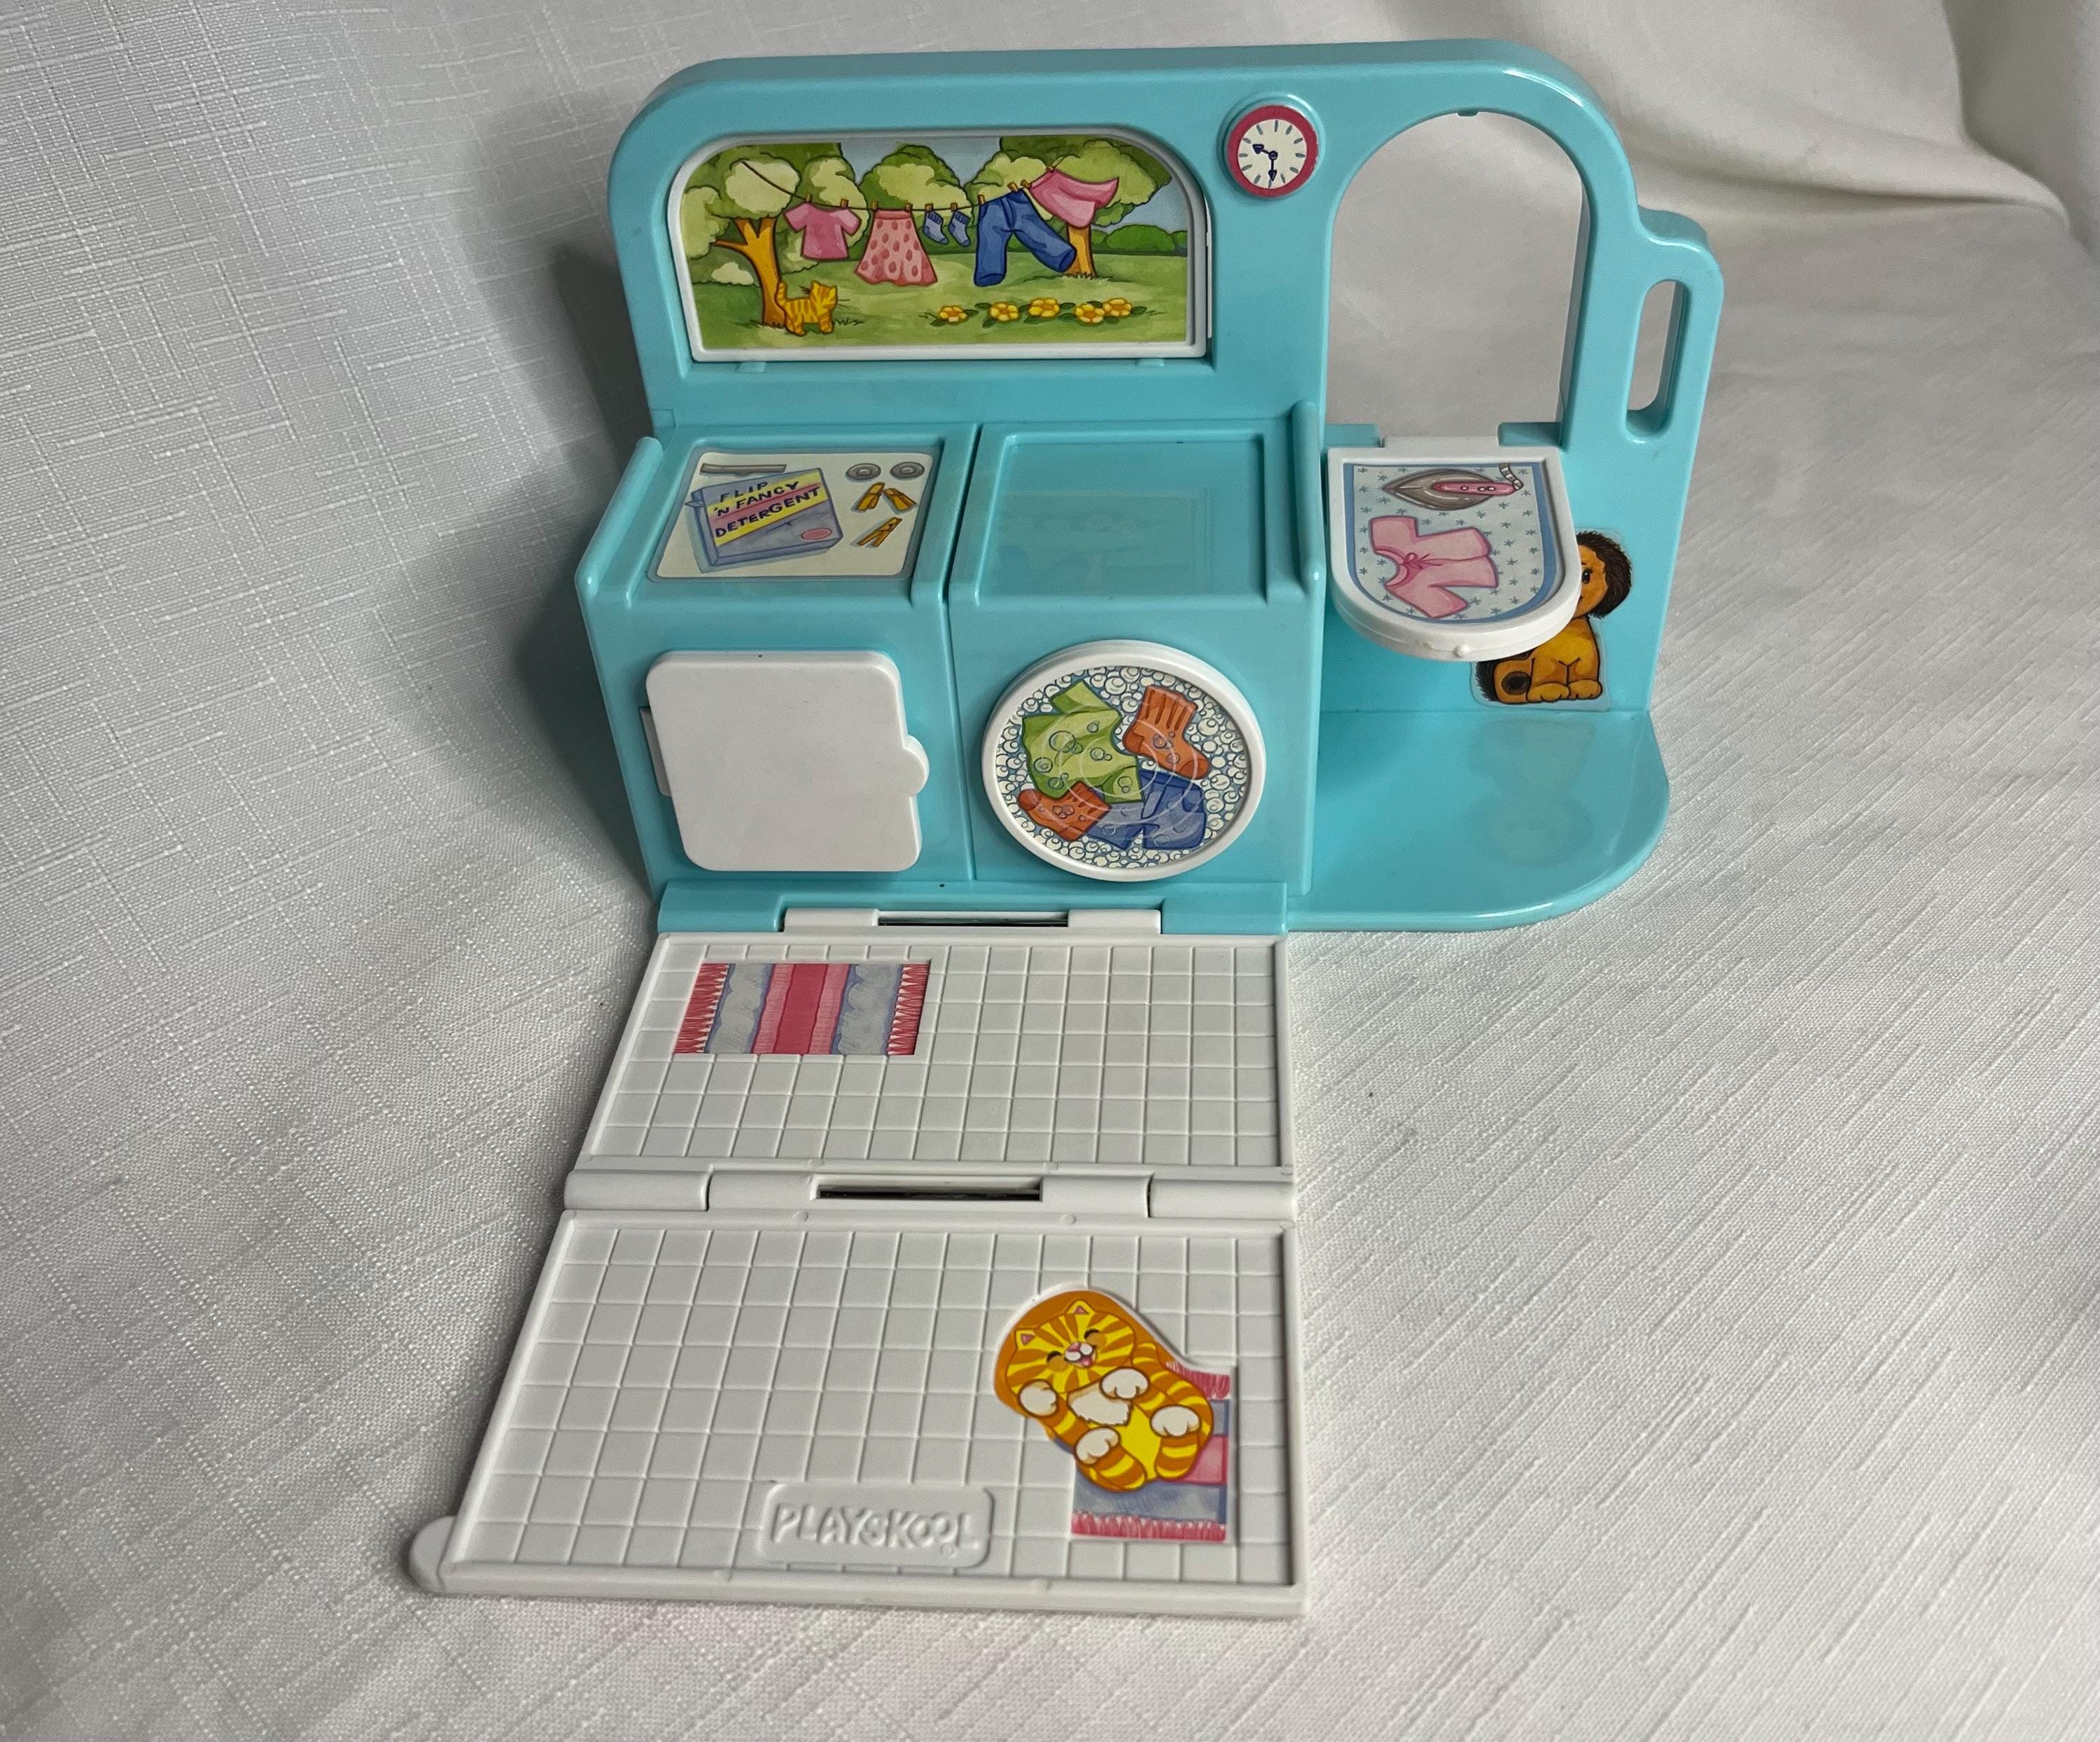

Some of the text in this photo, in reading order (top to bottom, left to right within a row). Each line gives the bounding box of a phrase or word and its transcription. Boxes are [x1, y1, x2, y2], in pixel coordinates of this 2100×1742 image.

[720, 482, 768, 503] FLIP
[736, 481, 799, 509] FANCY
[715, 487, 821, 538] DETERGENT
[771, 1504, 981, 1549] PLAYSKOOL
